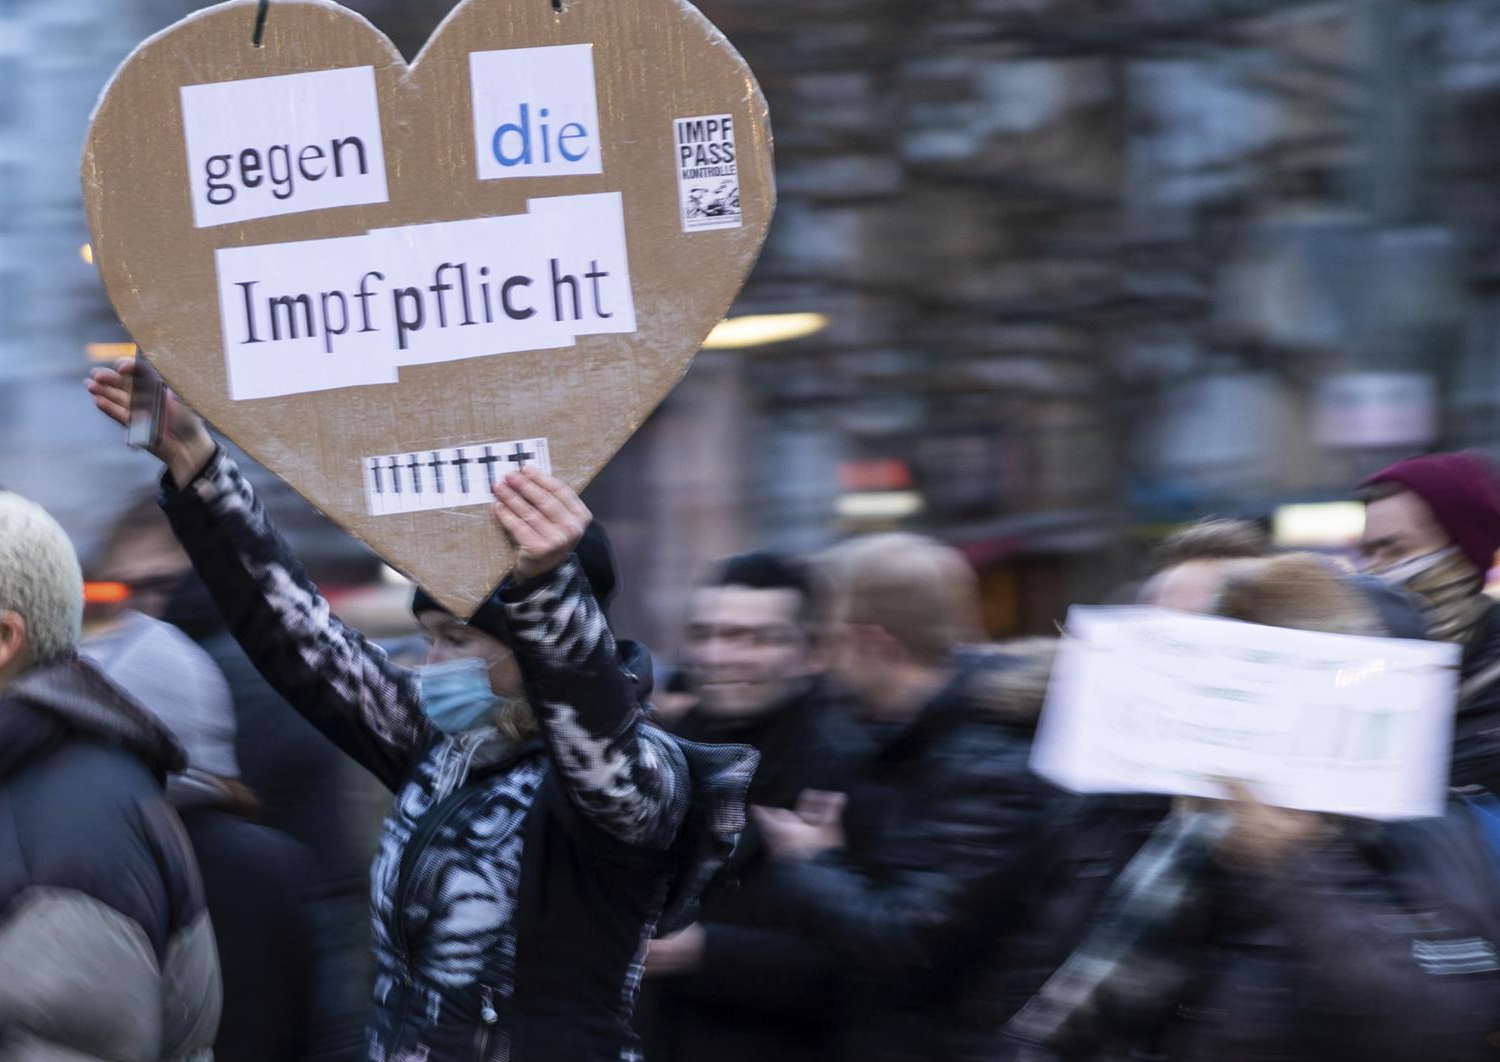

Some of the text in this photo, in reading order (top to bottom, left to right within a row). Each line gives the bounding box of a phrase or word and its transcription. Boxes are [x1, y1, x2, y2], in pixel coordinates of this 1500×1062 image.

[204, 102, 589, 205] gegen die
[678, 118, 732, 144] IMPF
[680, 142, 735, 168] PASS
[235, 257, 614, 355] Impfpflicht
